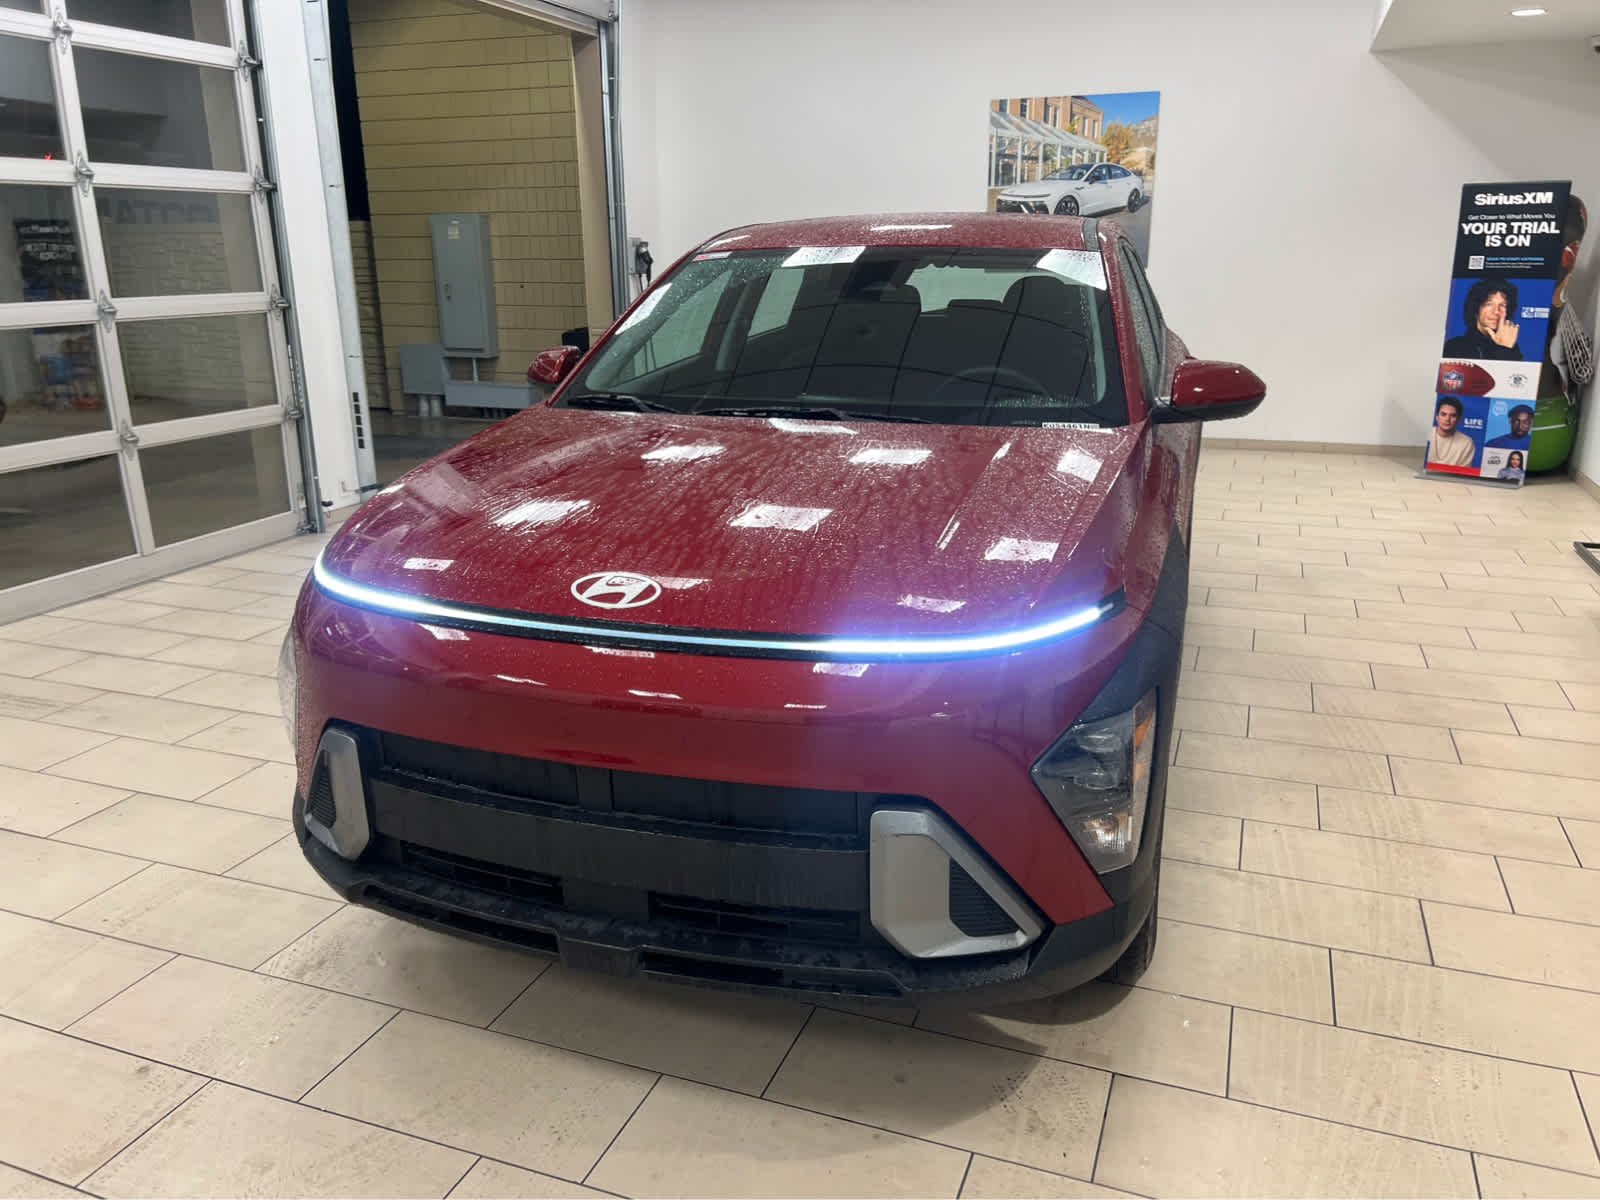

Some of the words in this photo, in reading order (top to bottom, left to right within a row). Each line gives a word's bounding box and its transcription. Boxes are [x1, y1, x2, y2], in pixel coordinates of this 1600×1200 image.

[1474, 191, 1554, 206] SiriusXM
[1461, 222, 1507, 235] YOUR
[1510, 221, 1560, 234] TRIAL
[1485, 235, 1502, 247] IS
[1505, 234, 1531, 247] ON
